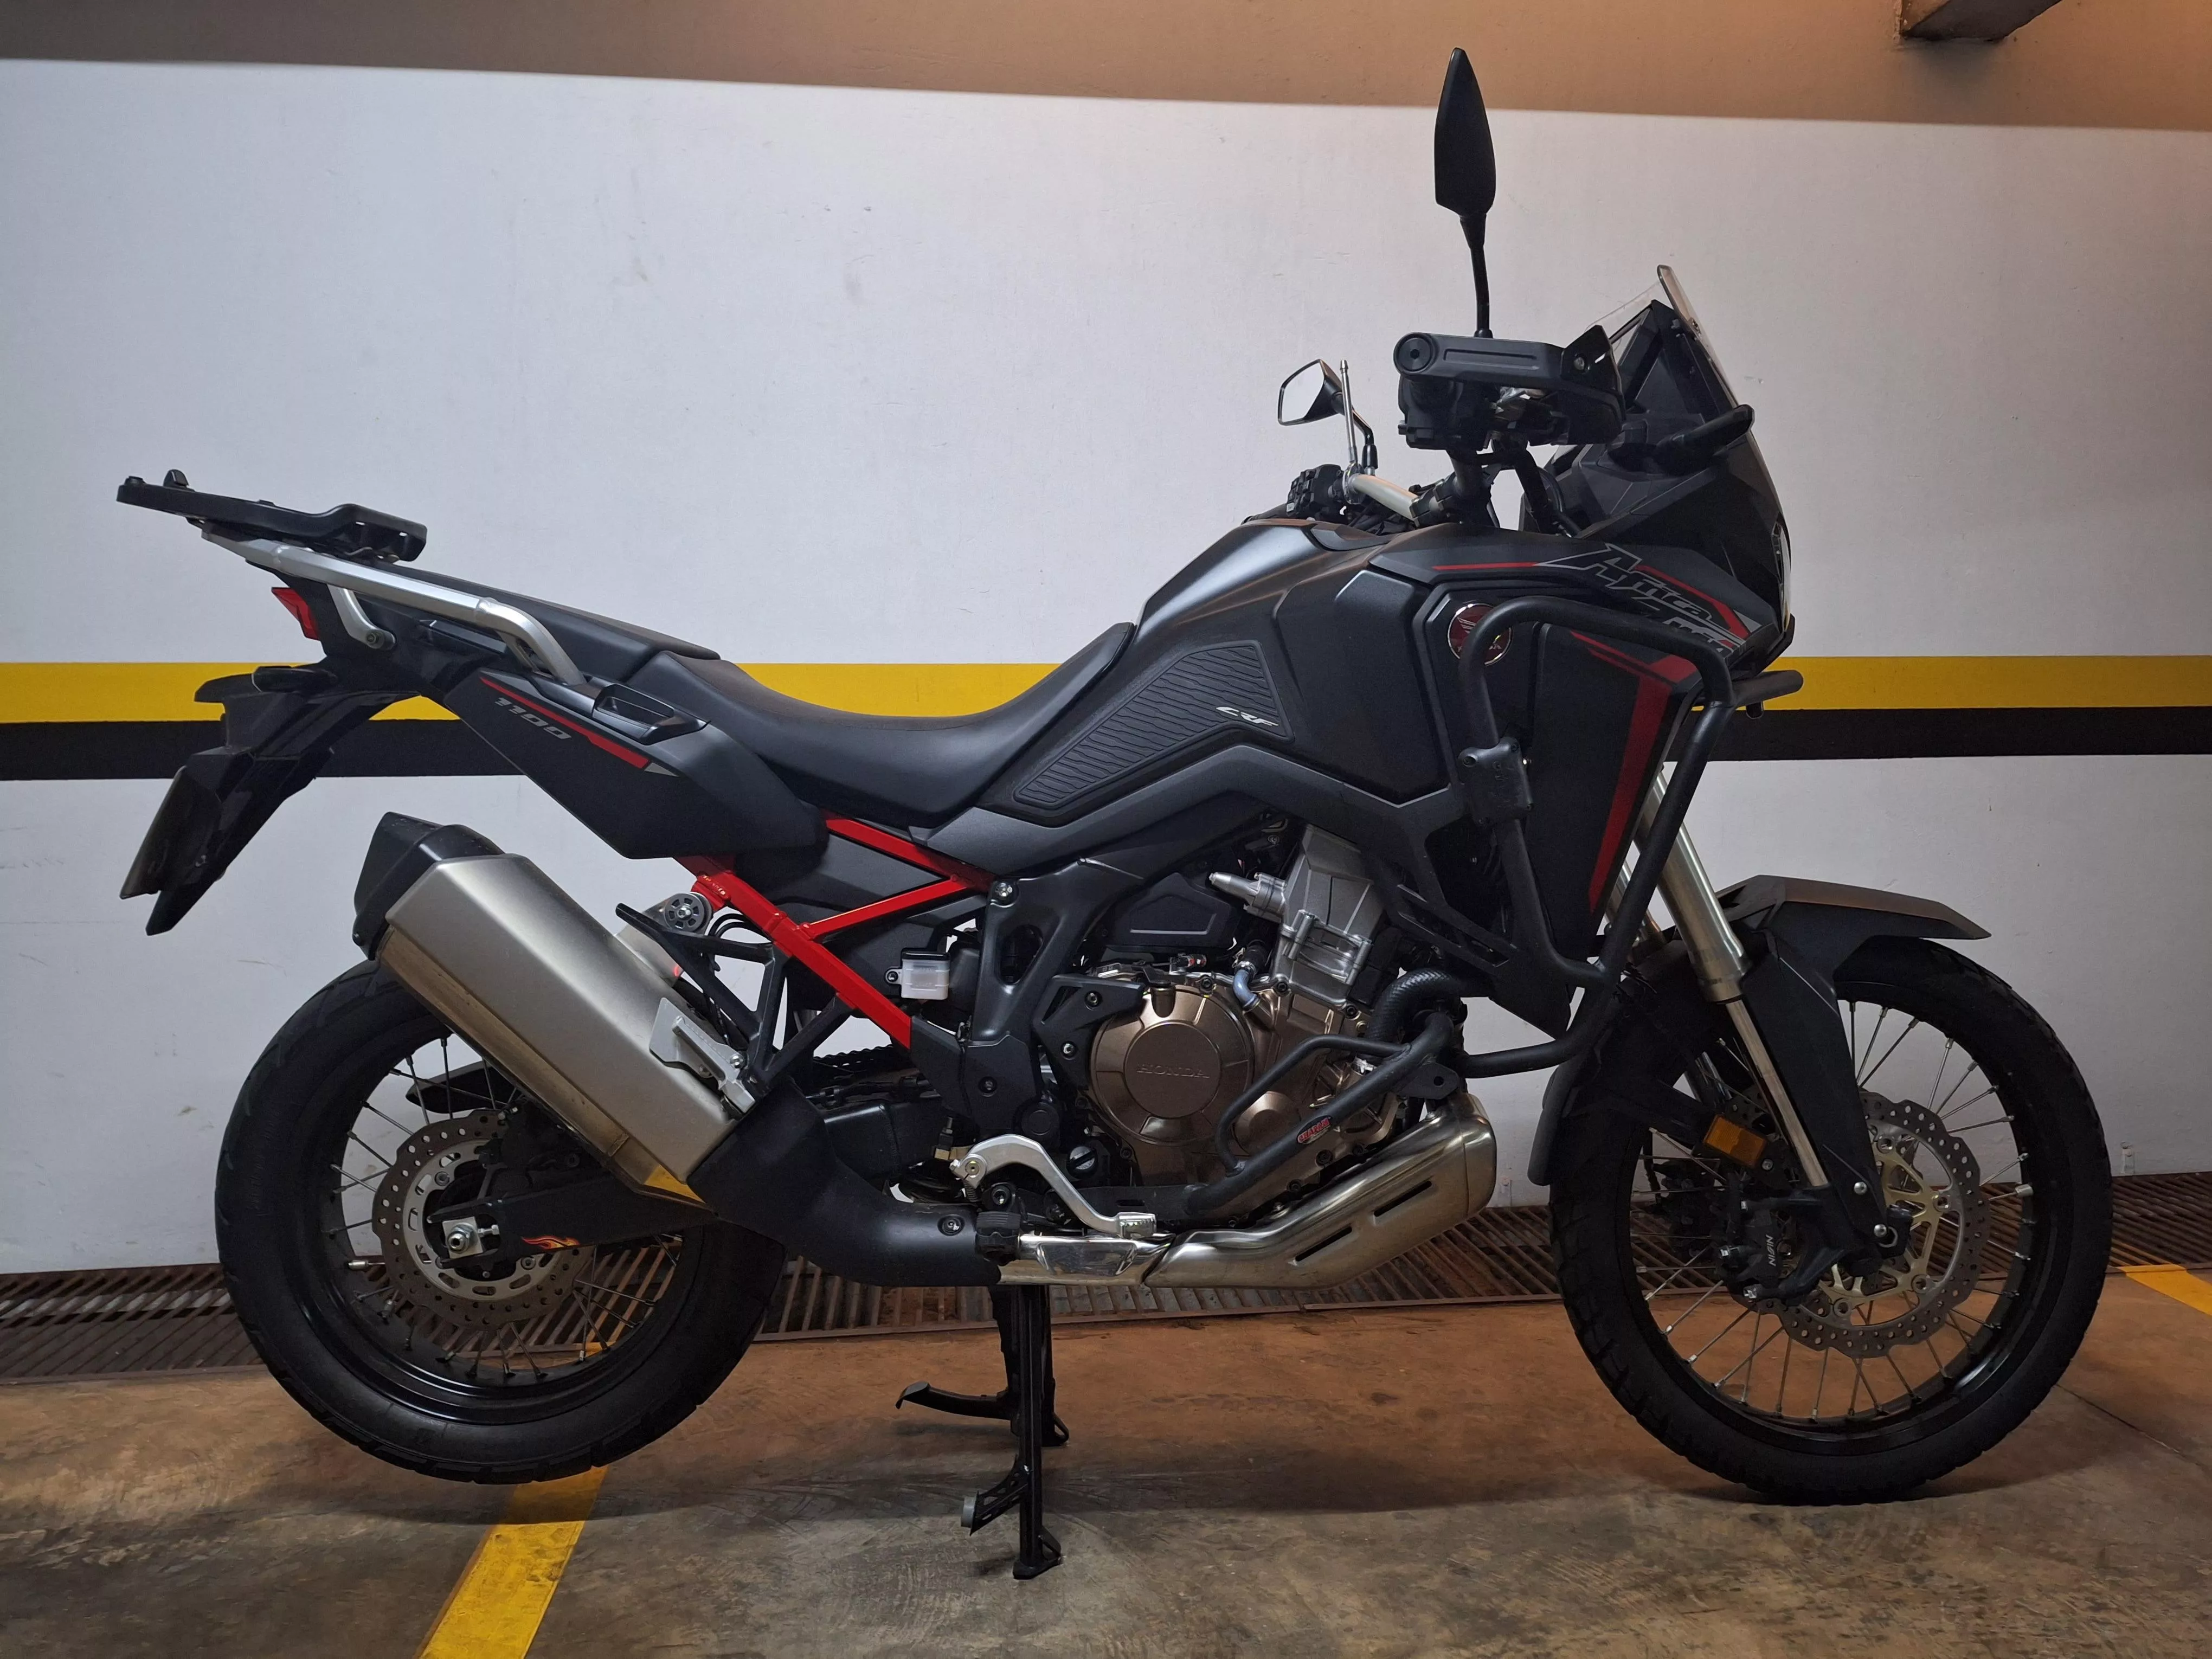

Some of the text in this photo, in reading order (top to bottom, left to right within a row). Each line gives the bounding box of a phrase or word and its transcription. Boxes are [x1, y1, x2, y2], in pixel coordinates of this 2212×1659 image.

[494, 697, 572, 740] 1100
[1216, 706, 1279, 726] CRF
[1137, 1064, 1211, 1079] HONDA
[1765, 1234, 1777, 1266] NISSIN
